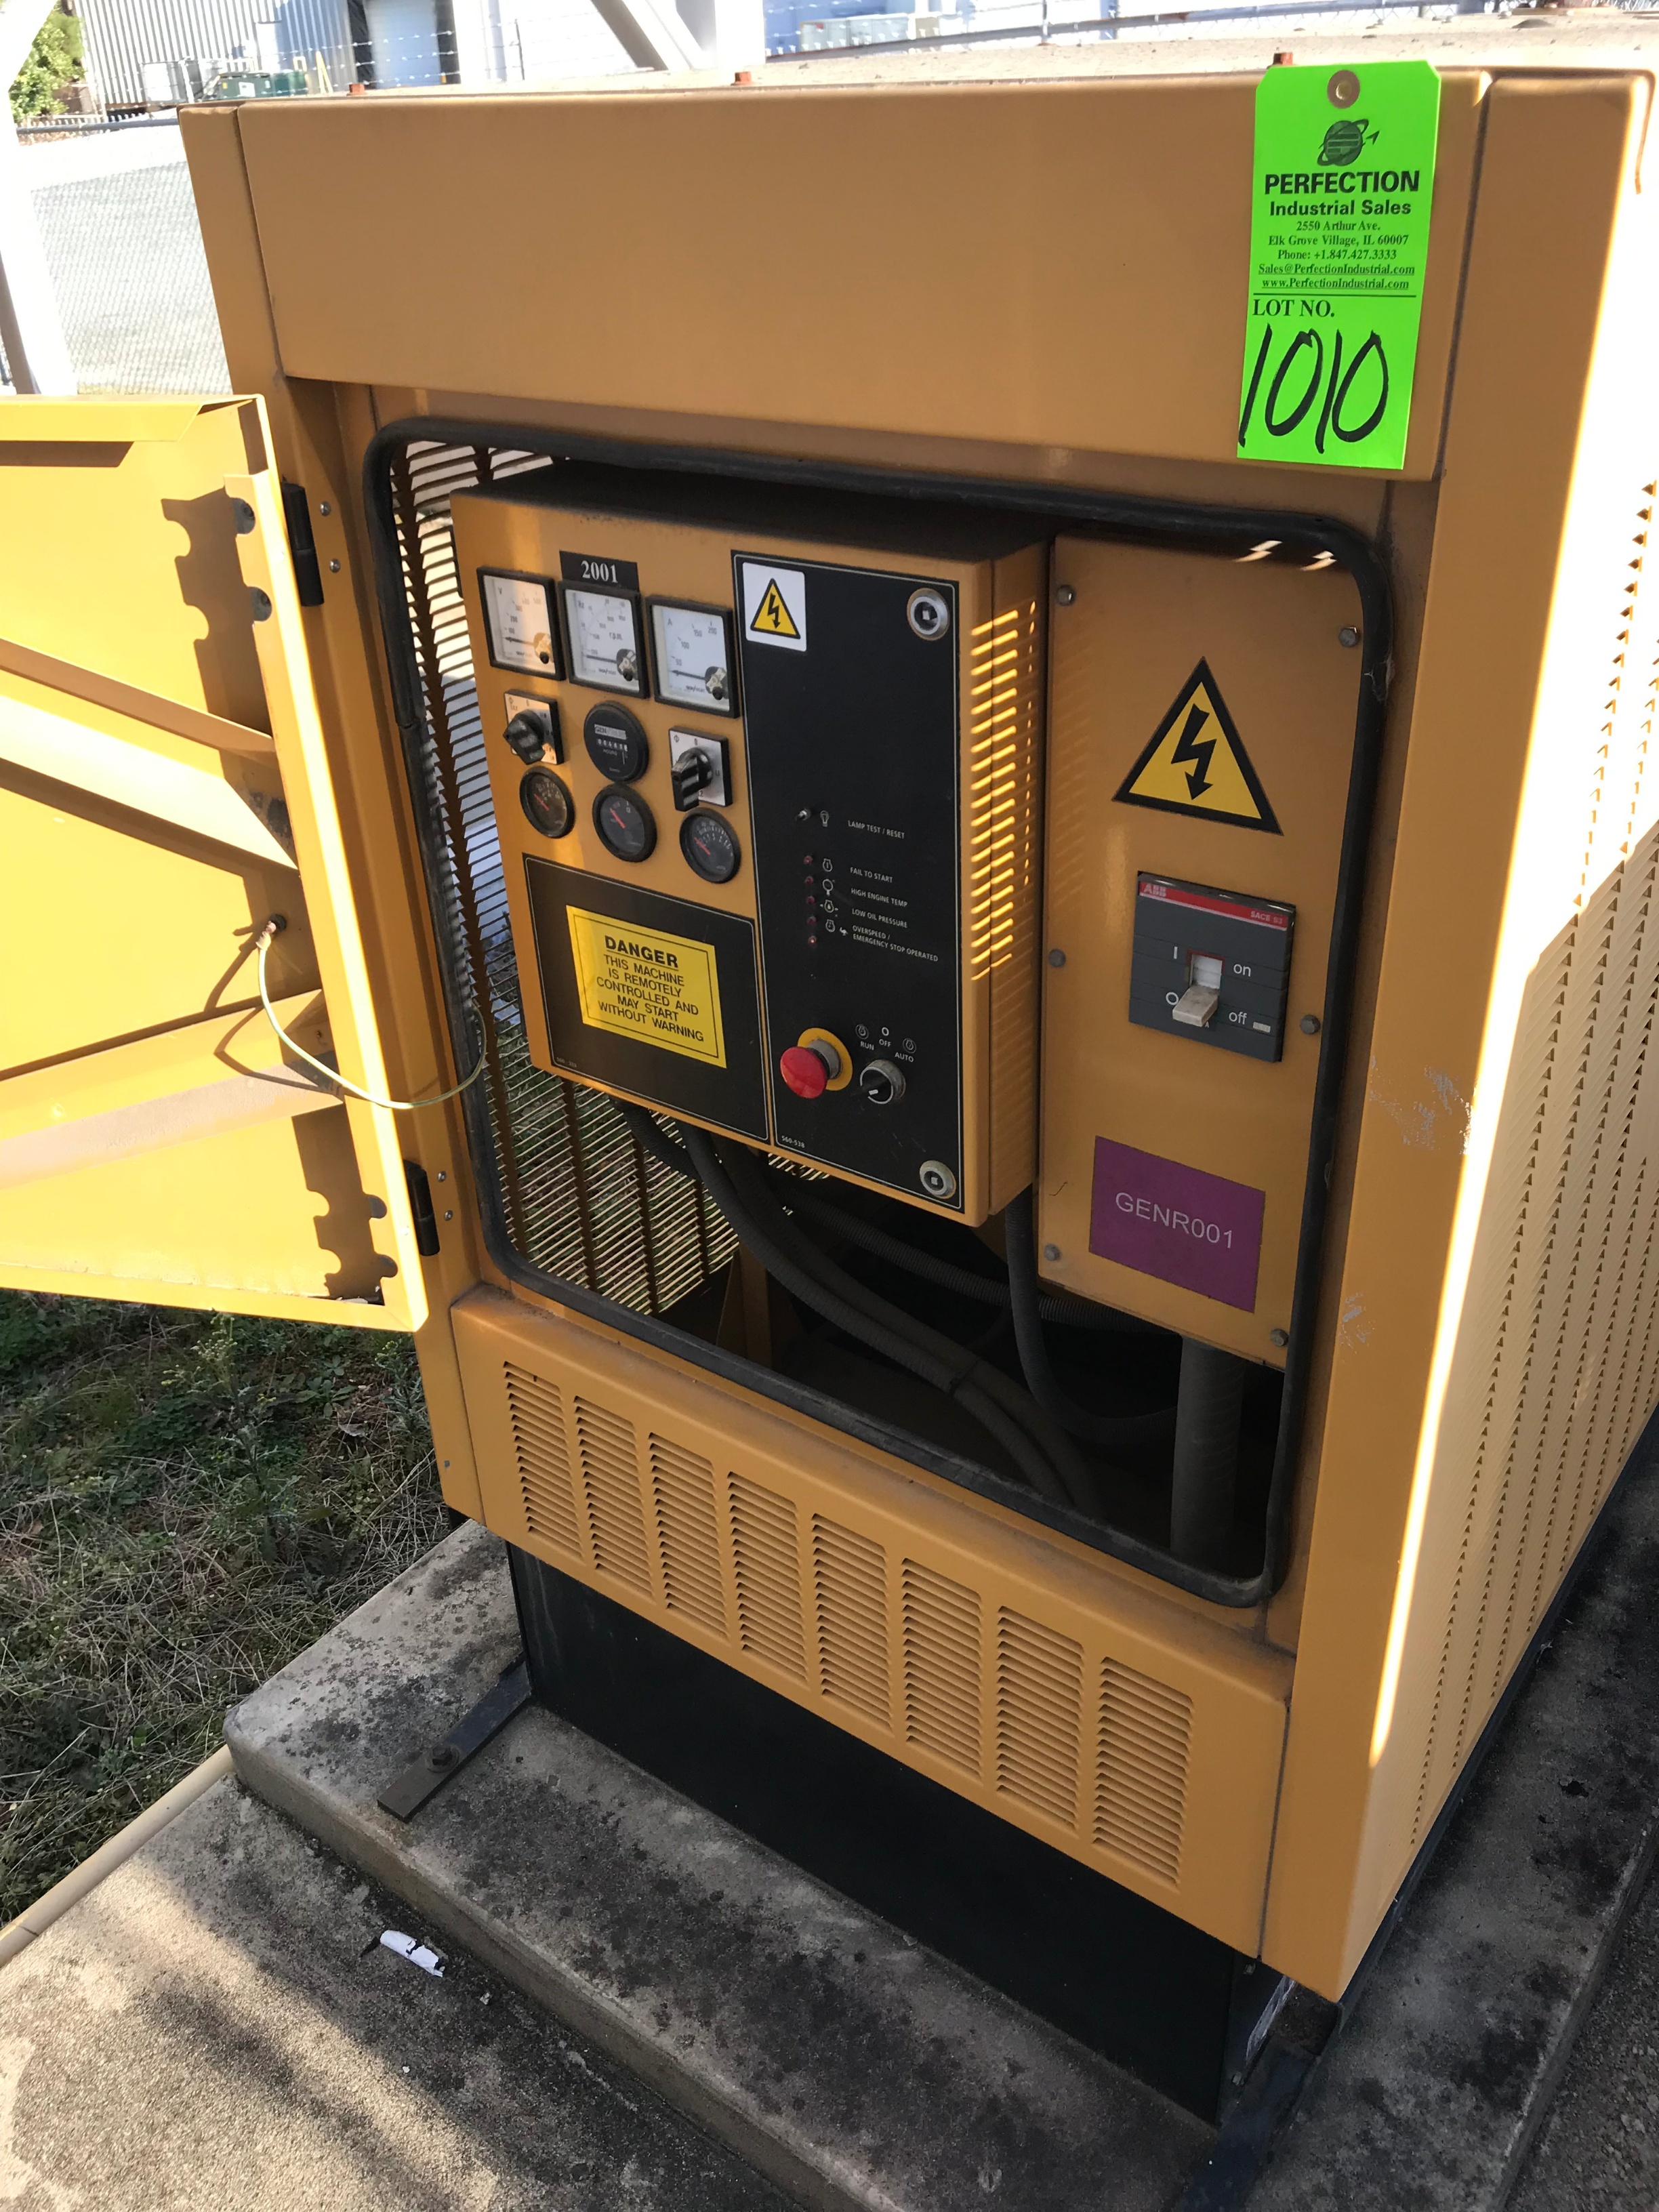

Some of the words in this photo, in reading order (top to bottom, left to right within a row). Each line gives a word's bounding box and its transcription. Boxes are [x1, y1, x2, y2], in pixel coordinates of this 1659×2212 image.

[1265, 170, 1420, 194] PERFECTION
[1270, 200, 1355, 216] Industrial
[1361, 199, 1411, 215] Sales
[1296, 221, 1320, 230] 2550
[1322, 221, 1356, 231] Arthur
[1358, 221, 1380, 231] Ave.
[1268, 235, 1285, 245] Elk
[1288, 235, 1318, 245] Grove
[1322, 234, 1359, 247] Village,
[1363, 235, 1374, 245] IL
[1377, 234, 1409, 245] 60007
[1277, 249, 1311, 260] Phone:
[1314, 249, 1397, 260] +1.847.427.3333
[1258, 264, 1414, 275] Sales@PerfectionIndustrial.com
[1262, 278, 1410, 289] www.PerfectionIndustrial.com
[1252, 299, 1294, 316] LOT
[1299, 300, 1334, 317] NO.
[1237, 323, 1389, 454] 1010
[581, 560, 618, 583] 2001
[693, 629, 702, 637] 150
[708, 626, 717, 635] 200
[681, 641, 690, 649] 100
[848, 820, 865, 830] LAMP
[866, 824, 880, 834] TEST
[886, 829, 905, 839] RESET
[850, 867, 863, 876] FAIL
[874, 872, 893, 883] START
[851, 888, 866, 897] HIGH
[867, 892, 889, 903] ENGINE
[890, 898, 908, 907] TEMP
[1143, 883, 1167, 897] ABB
[852, 908, 866, 917] LOW
[867, 912, 877, 920] OIL
[878, 915, 907, 928] PRESSURE
[1250, 910, 1271, 922] SACE
[853, 925, 886, 939] OVERSPEED
[605, 935, 678, 968] DANGER
[853, 933, 888, 948] EMERGENCY
[890, 943, 905, 952] STOP
[906, 948, 939, 962] OPERATED
[603, 954, 629, 970] THIS
[634, 962, 684, 987] MACHINE
[1233, 963, 1251, 977] on
[609, 968, 619, 980] IS
[624, 971, 681, 998] REMOTELY
[596, 976, 670, 1007] CONTROLLED
[675, 1000, 699, 1016] AND
[617, 994, 639, 1009] MAY
[644, 1002, 679, 1021] START
[598, 1000, 647, 1024] WITHOUT
[651, 1017, 704, 1042] WARNING
[1229, 1011, 1248, 1025] off
[860, 1041, 874, 1050] RUN
[879, 1039, 891, 1047] OFF
[895, 1052, 914, 1063] AUTO
[1115, 1192, 1233, 1249] GENR001
